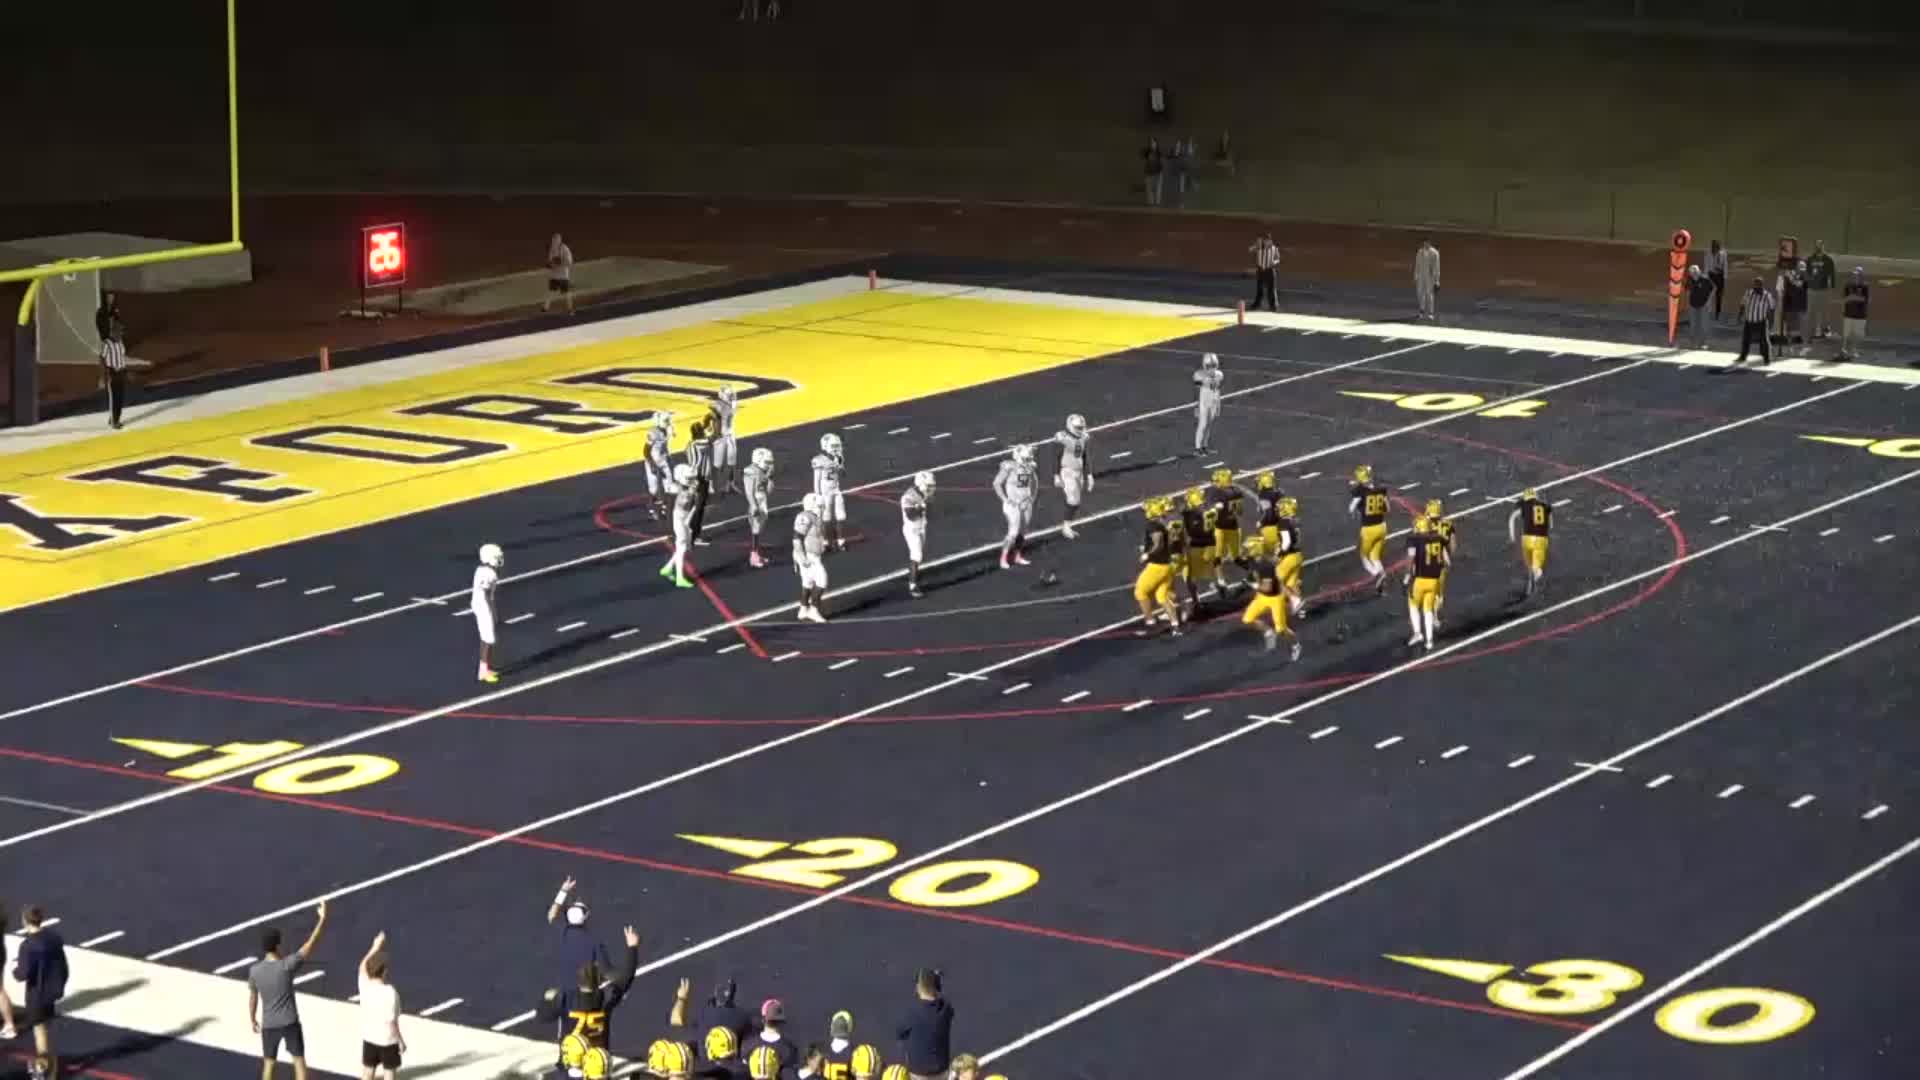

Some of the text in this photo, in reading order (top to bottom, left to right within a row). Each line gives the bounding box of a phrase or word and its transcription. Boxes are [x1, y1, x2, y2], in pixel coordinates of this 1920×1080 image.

[1533, 505, 1545, 525] 8
[165, 739, 401, 795] 10
[728, 836, 1041, 907] 20
[568, 1011, 604, 1037] 75
[1485, 957, 1817, 1045] 30
